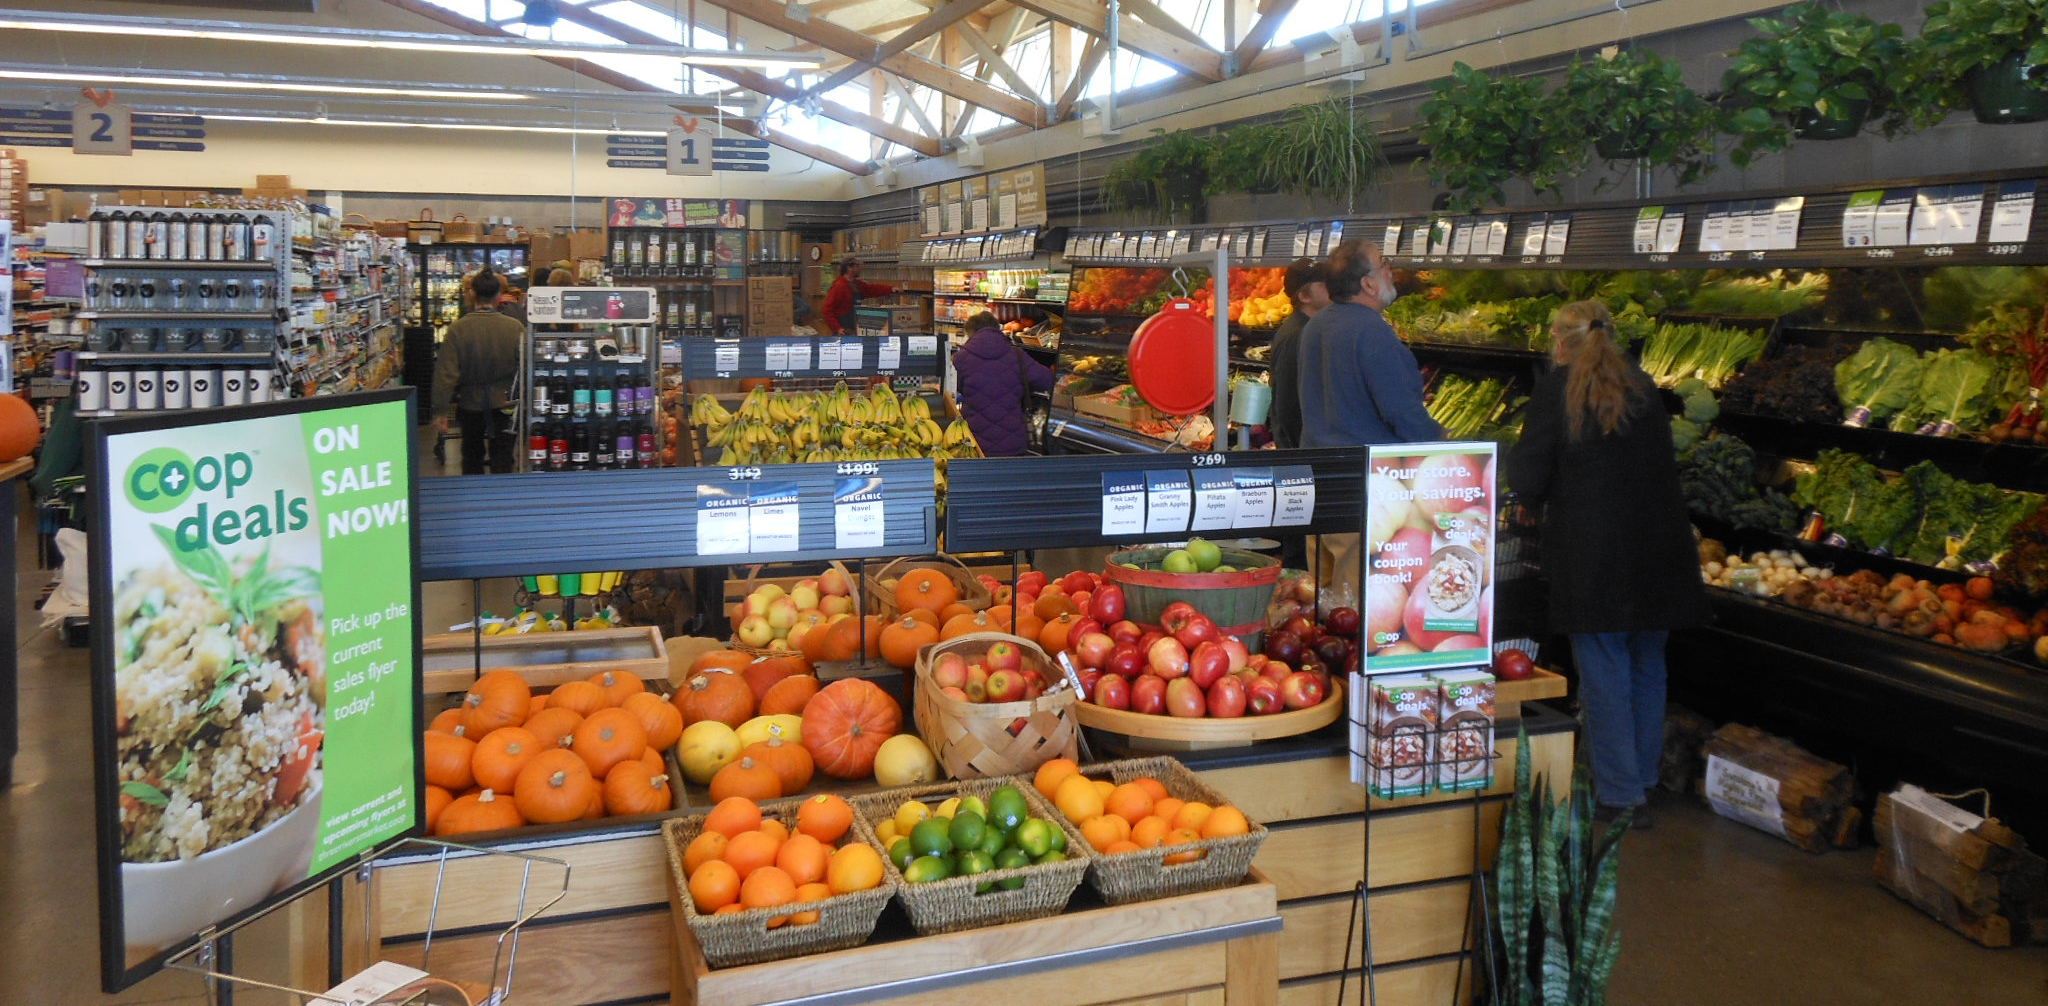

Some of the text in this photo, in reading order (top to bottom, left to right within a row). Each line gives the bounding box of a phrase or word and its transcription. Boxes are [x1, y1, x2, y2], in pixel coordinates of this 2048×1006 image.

[90, 112, 114, 142] 2
[681, 139, 699, 164] 1
[313, 424, 360, 454] ON
[1376, 465, 1472, 480] Your store.
[321, 461, 392, 497] SALE
[1240, 479, 1273, 488] ORGANIC
[1281, 477, 1313, 485] ORGANIC
[1109, 484, 1144, 493] ORGANIC
[1154, 482, 1189, 490] ORGANIC
[1201, 481, 1235, 490] ORGANIC
[757, 495, 799, 504] ORGANIC
[842, 493, 882, 502] ORGANIC
[1124, 495, 1138, 503] Lady
[1158, 493, 1181, 501] Granny
[1379, 485, 1486, 503] Your savings.
[705, 498, 748, 508] ORGANIC
[851, 504, 871, 512] Navel
[1114, 504, 1134, 512] Apples
[1169, 501, 1189, 509] Apples
[1245, 498, 1264, 506] Apples
[175, 489, 309, 553] deals
[327, 499, 409, 539] NOW!
[1445, 528, 1477, 540] deals
[1376, 541, 1408, 552] Your
[1374, 557, 1423, 570] coupon
[1374, 571, 1413, 583] book!
[331, 602, 408, 637] Pick up the
[333, 637, 383, 664] current
[334, 660, 398, 693] sales flyer
[334, 690, 376, 721] today!
[1396, 701, 1429, 712] deals
[1455, 695, 1484, 707] deals
[326, 784, 403, 828] view current and
[323, 799, 407, 846] upcoming flyers at
